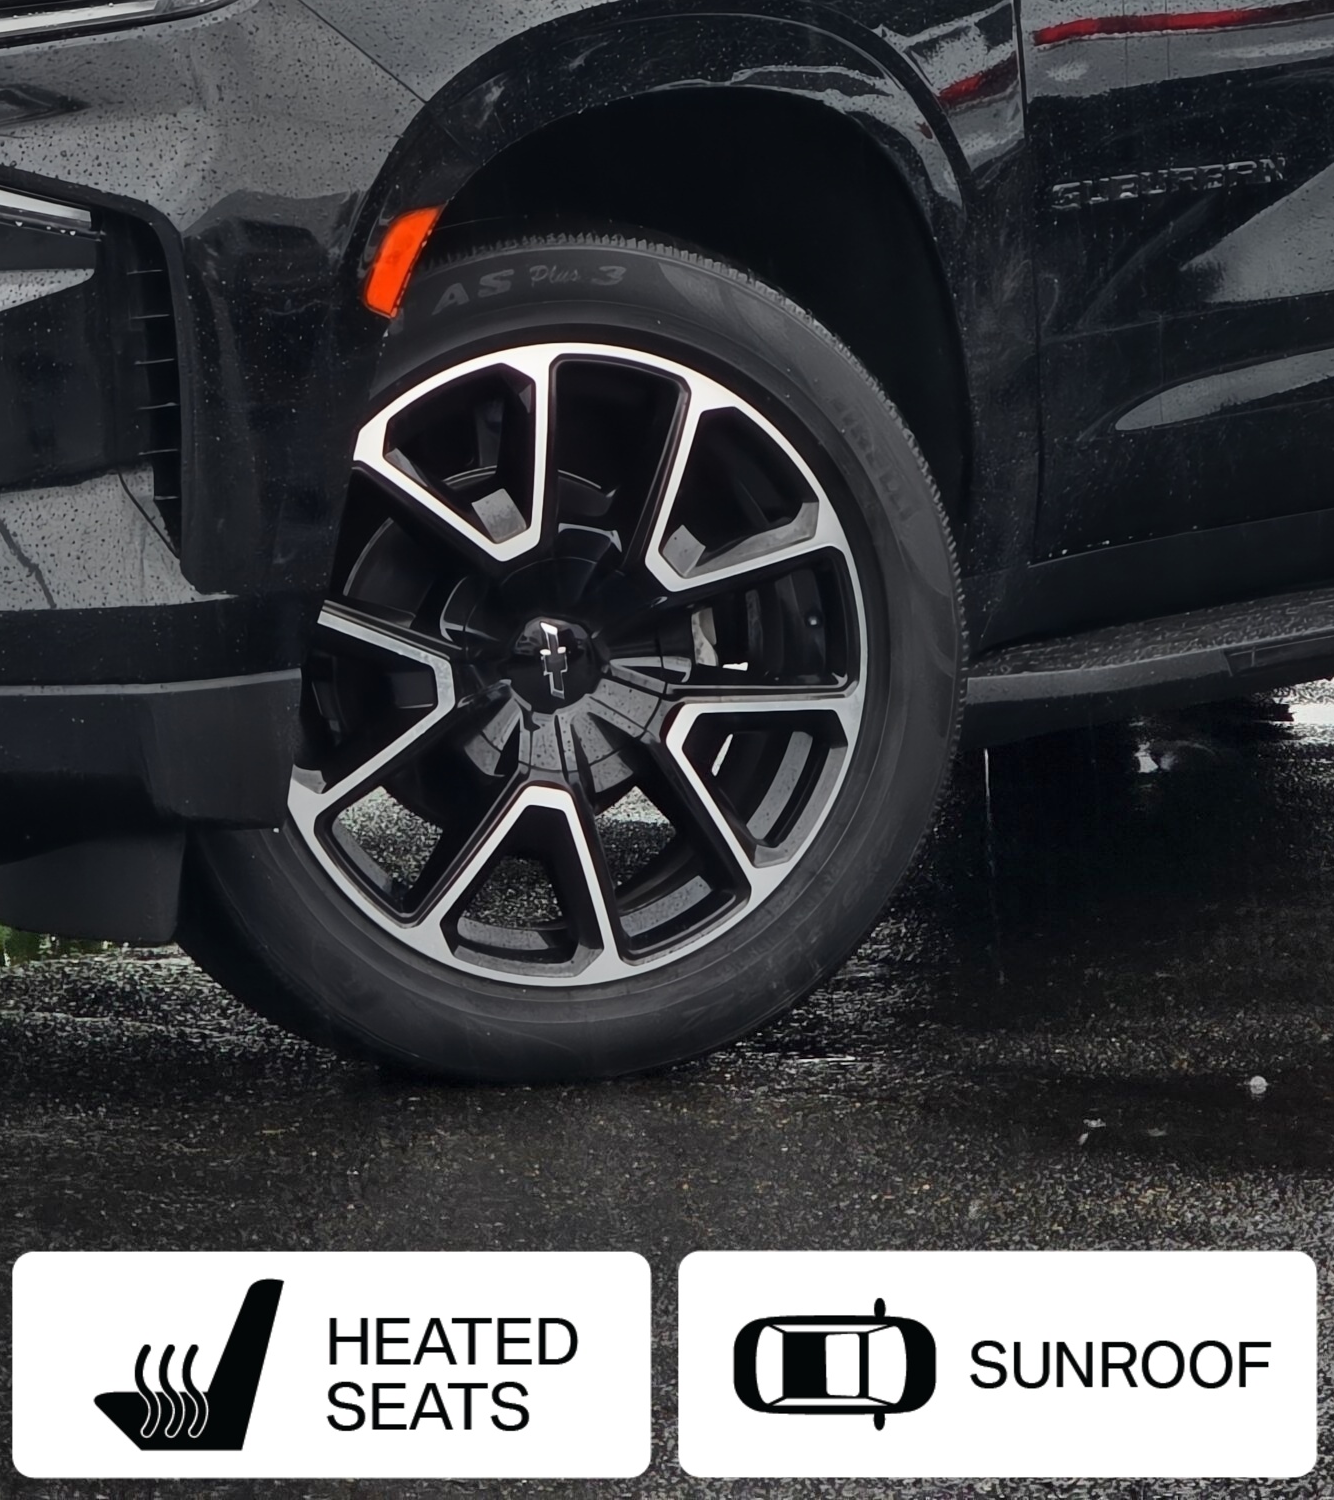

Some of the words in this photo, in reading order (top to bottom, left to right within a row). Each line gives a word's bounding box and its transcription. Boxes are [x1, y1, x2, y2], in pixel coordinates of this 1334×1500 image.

[430, 267, 516, 316] AS
[529, 264, 581, 288] Plus
[590, 264, 628, 286] 3
